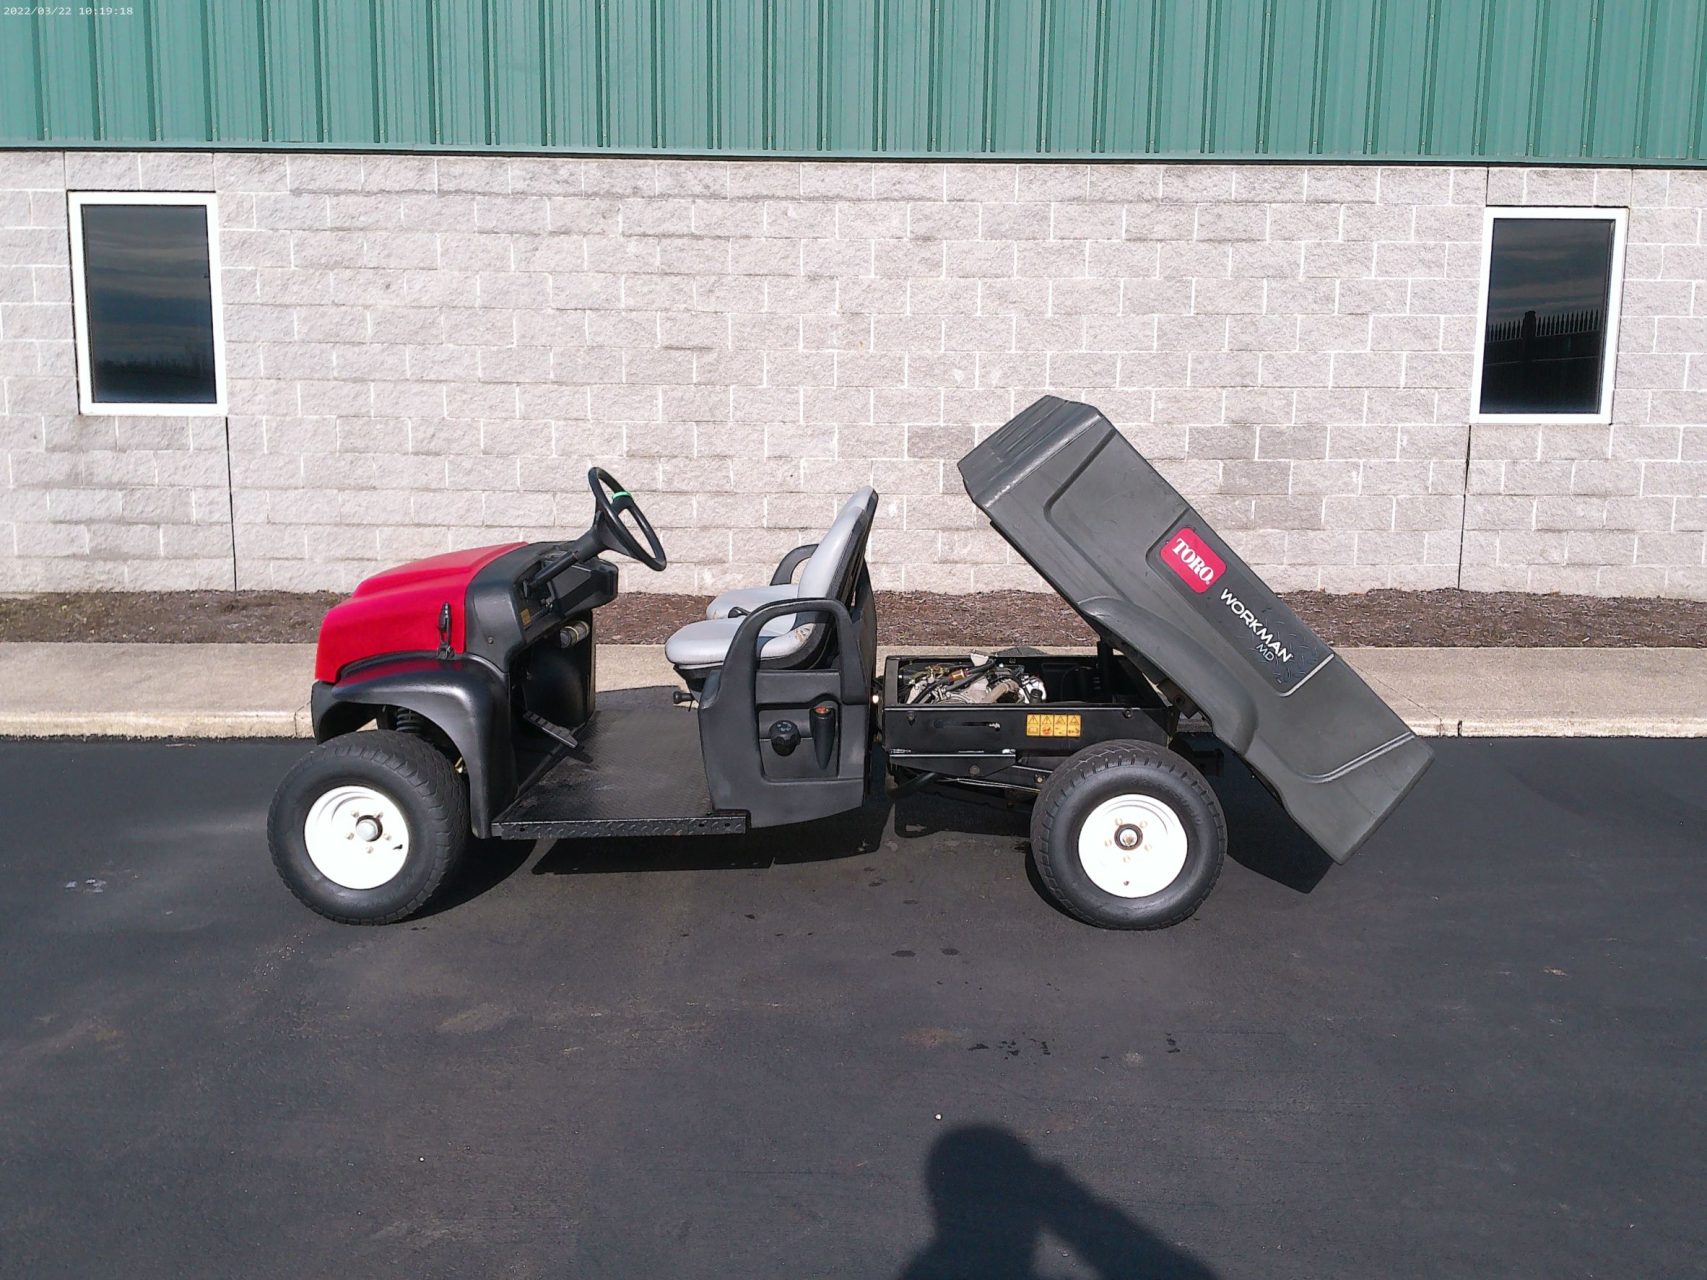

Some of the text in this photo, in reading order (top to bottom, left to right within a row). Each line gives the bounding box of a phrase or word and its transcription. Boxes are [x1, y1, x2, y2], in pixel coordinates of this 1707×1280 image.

[1172, 538, 1214, 583] TORO
[1220, 589, 1292, 662] WORKMAN
[1256, 644, 1275, 661] MD
